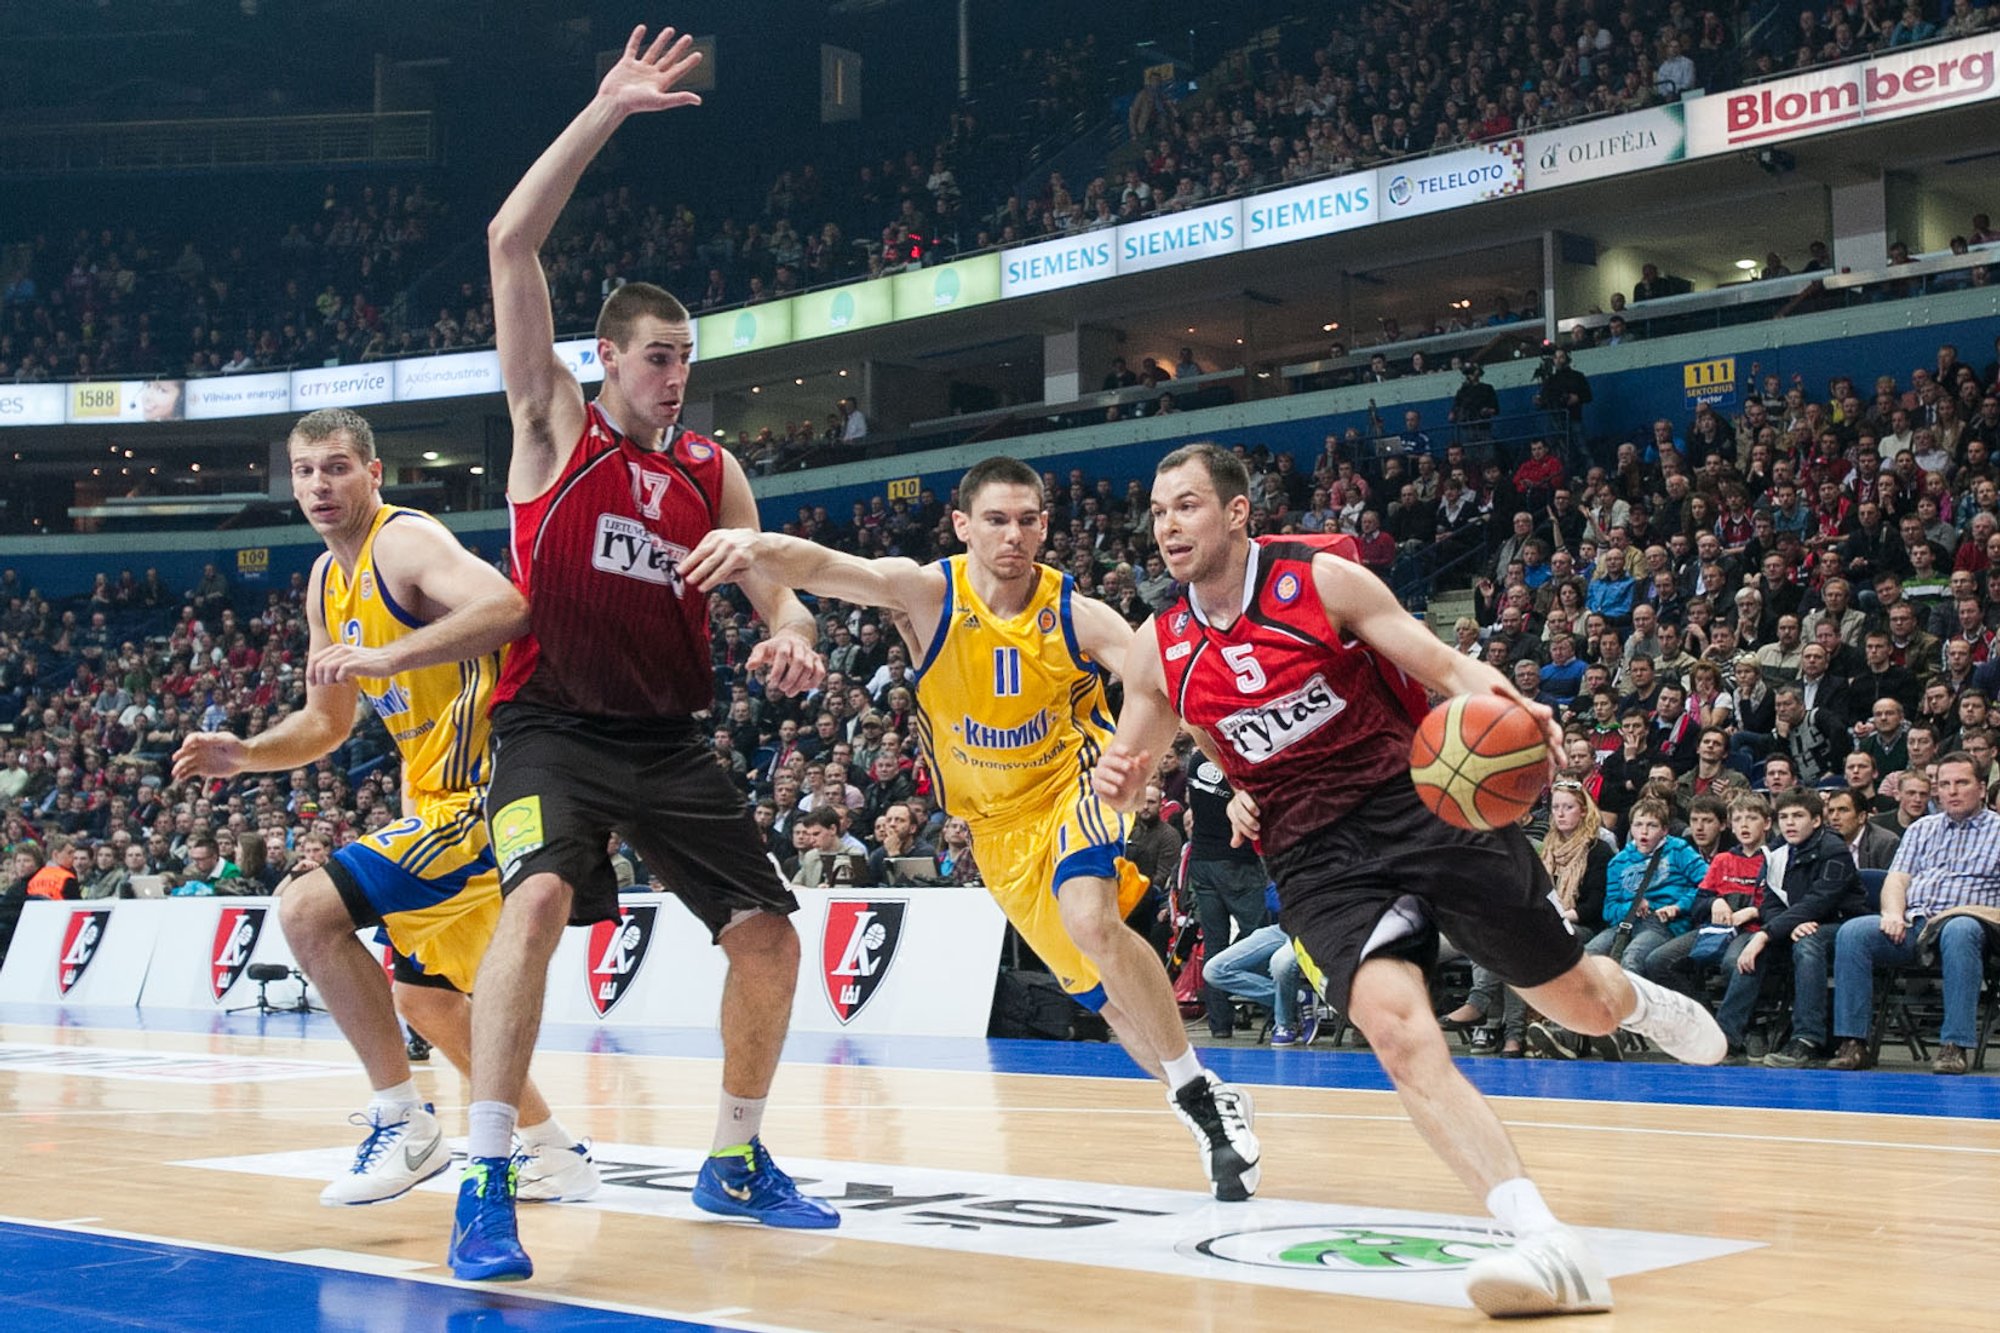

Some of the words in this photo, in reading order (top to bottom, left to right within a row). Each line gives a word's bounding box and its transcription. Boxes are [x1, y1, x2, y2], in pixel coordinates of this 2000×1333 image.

[1727, 50, 1995, 134] Blomberg
[1568, 129, 1658, 164] OLIFĖJA
[1417, 164, 1504, 195] TELELOTO
[1250, 187, 1370, 233] SIEMENS
[1123, 216, 1235, 260] SIEMENS
[1008, 243, 1110, 285] SIEMENS
[1693, 362, 1728, 384] 111
[79, 389, 115, 408] 1588
[627, 461, 671, 520] 17
[892, 480, 917, 496] 110
[242, 551, 266, 565] 109
[994, 647, 1021, 697] 11
[1221, 642, 1267, 694] 5
[963, 706, 1050, 749] KHIMKI
